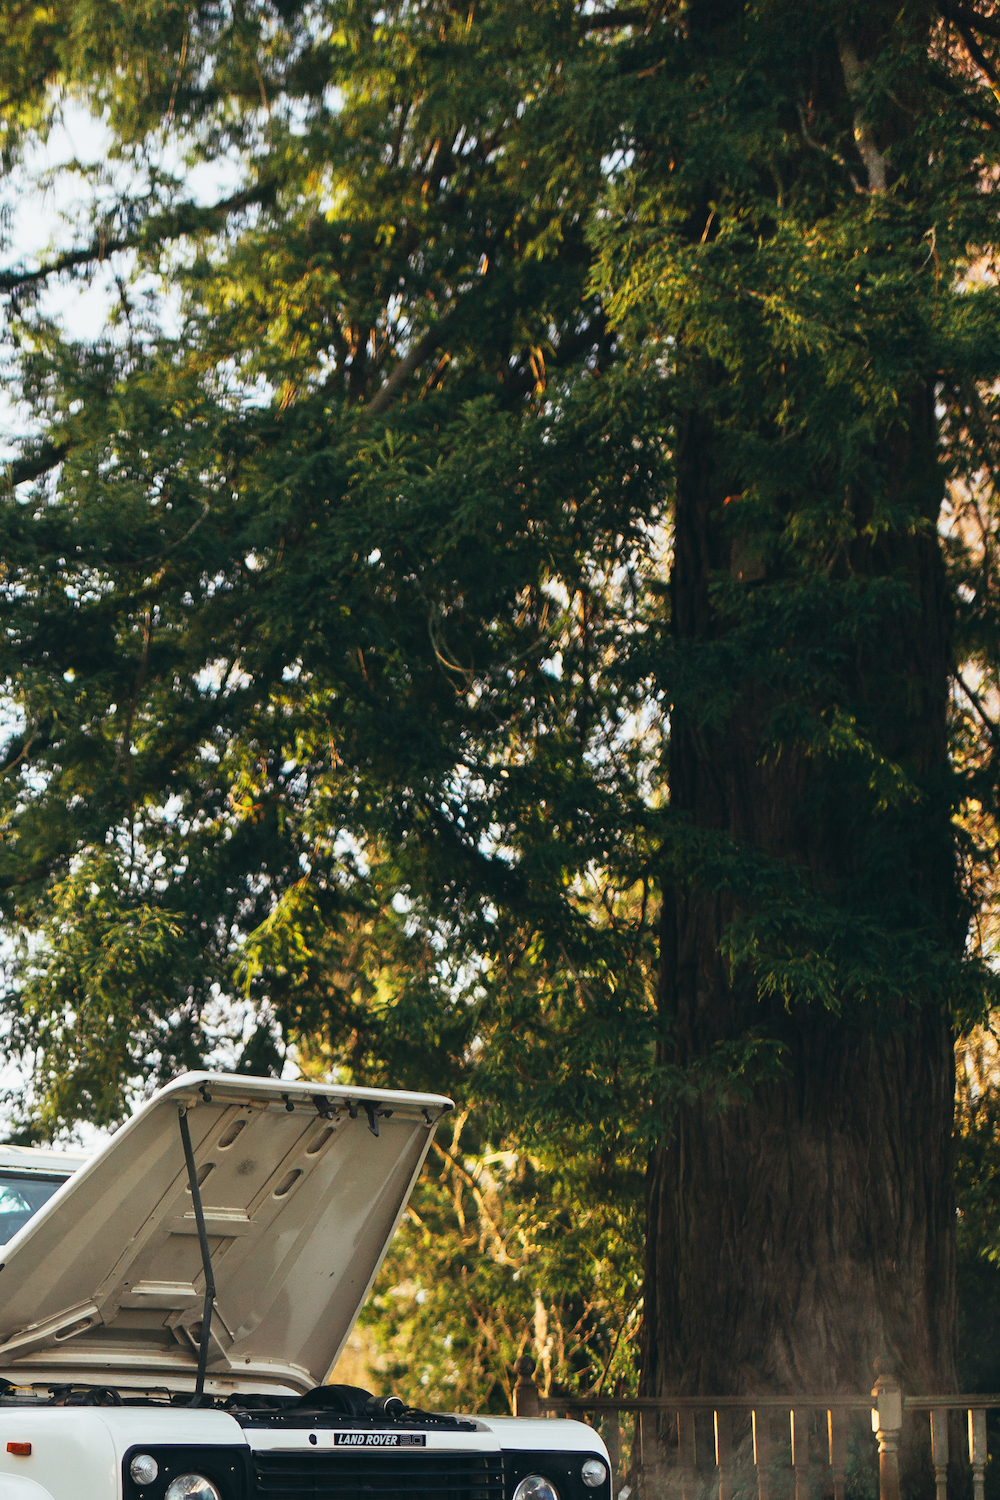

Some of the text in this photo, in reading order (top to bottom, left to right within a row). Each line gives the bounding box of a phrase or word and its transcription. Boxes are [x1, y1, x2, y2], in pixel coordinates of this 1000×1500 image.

[338, 1434, 423, 1446] LAND ROVER 90
